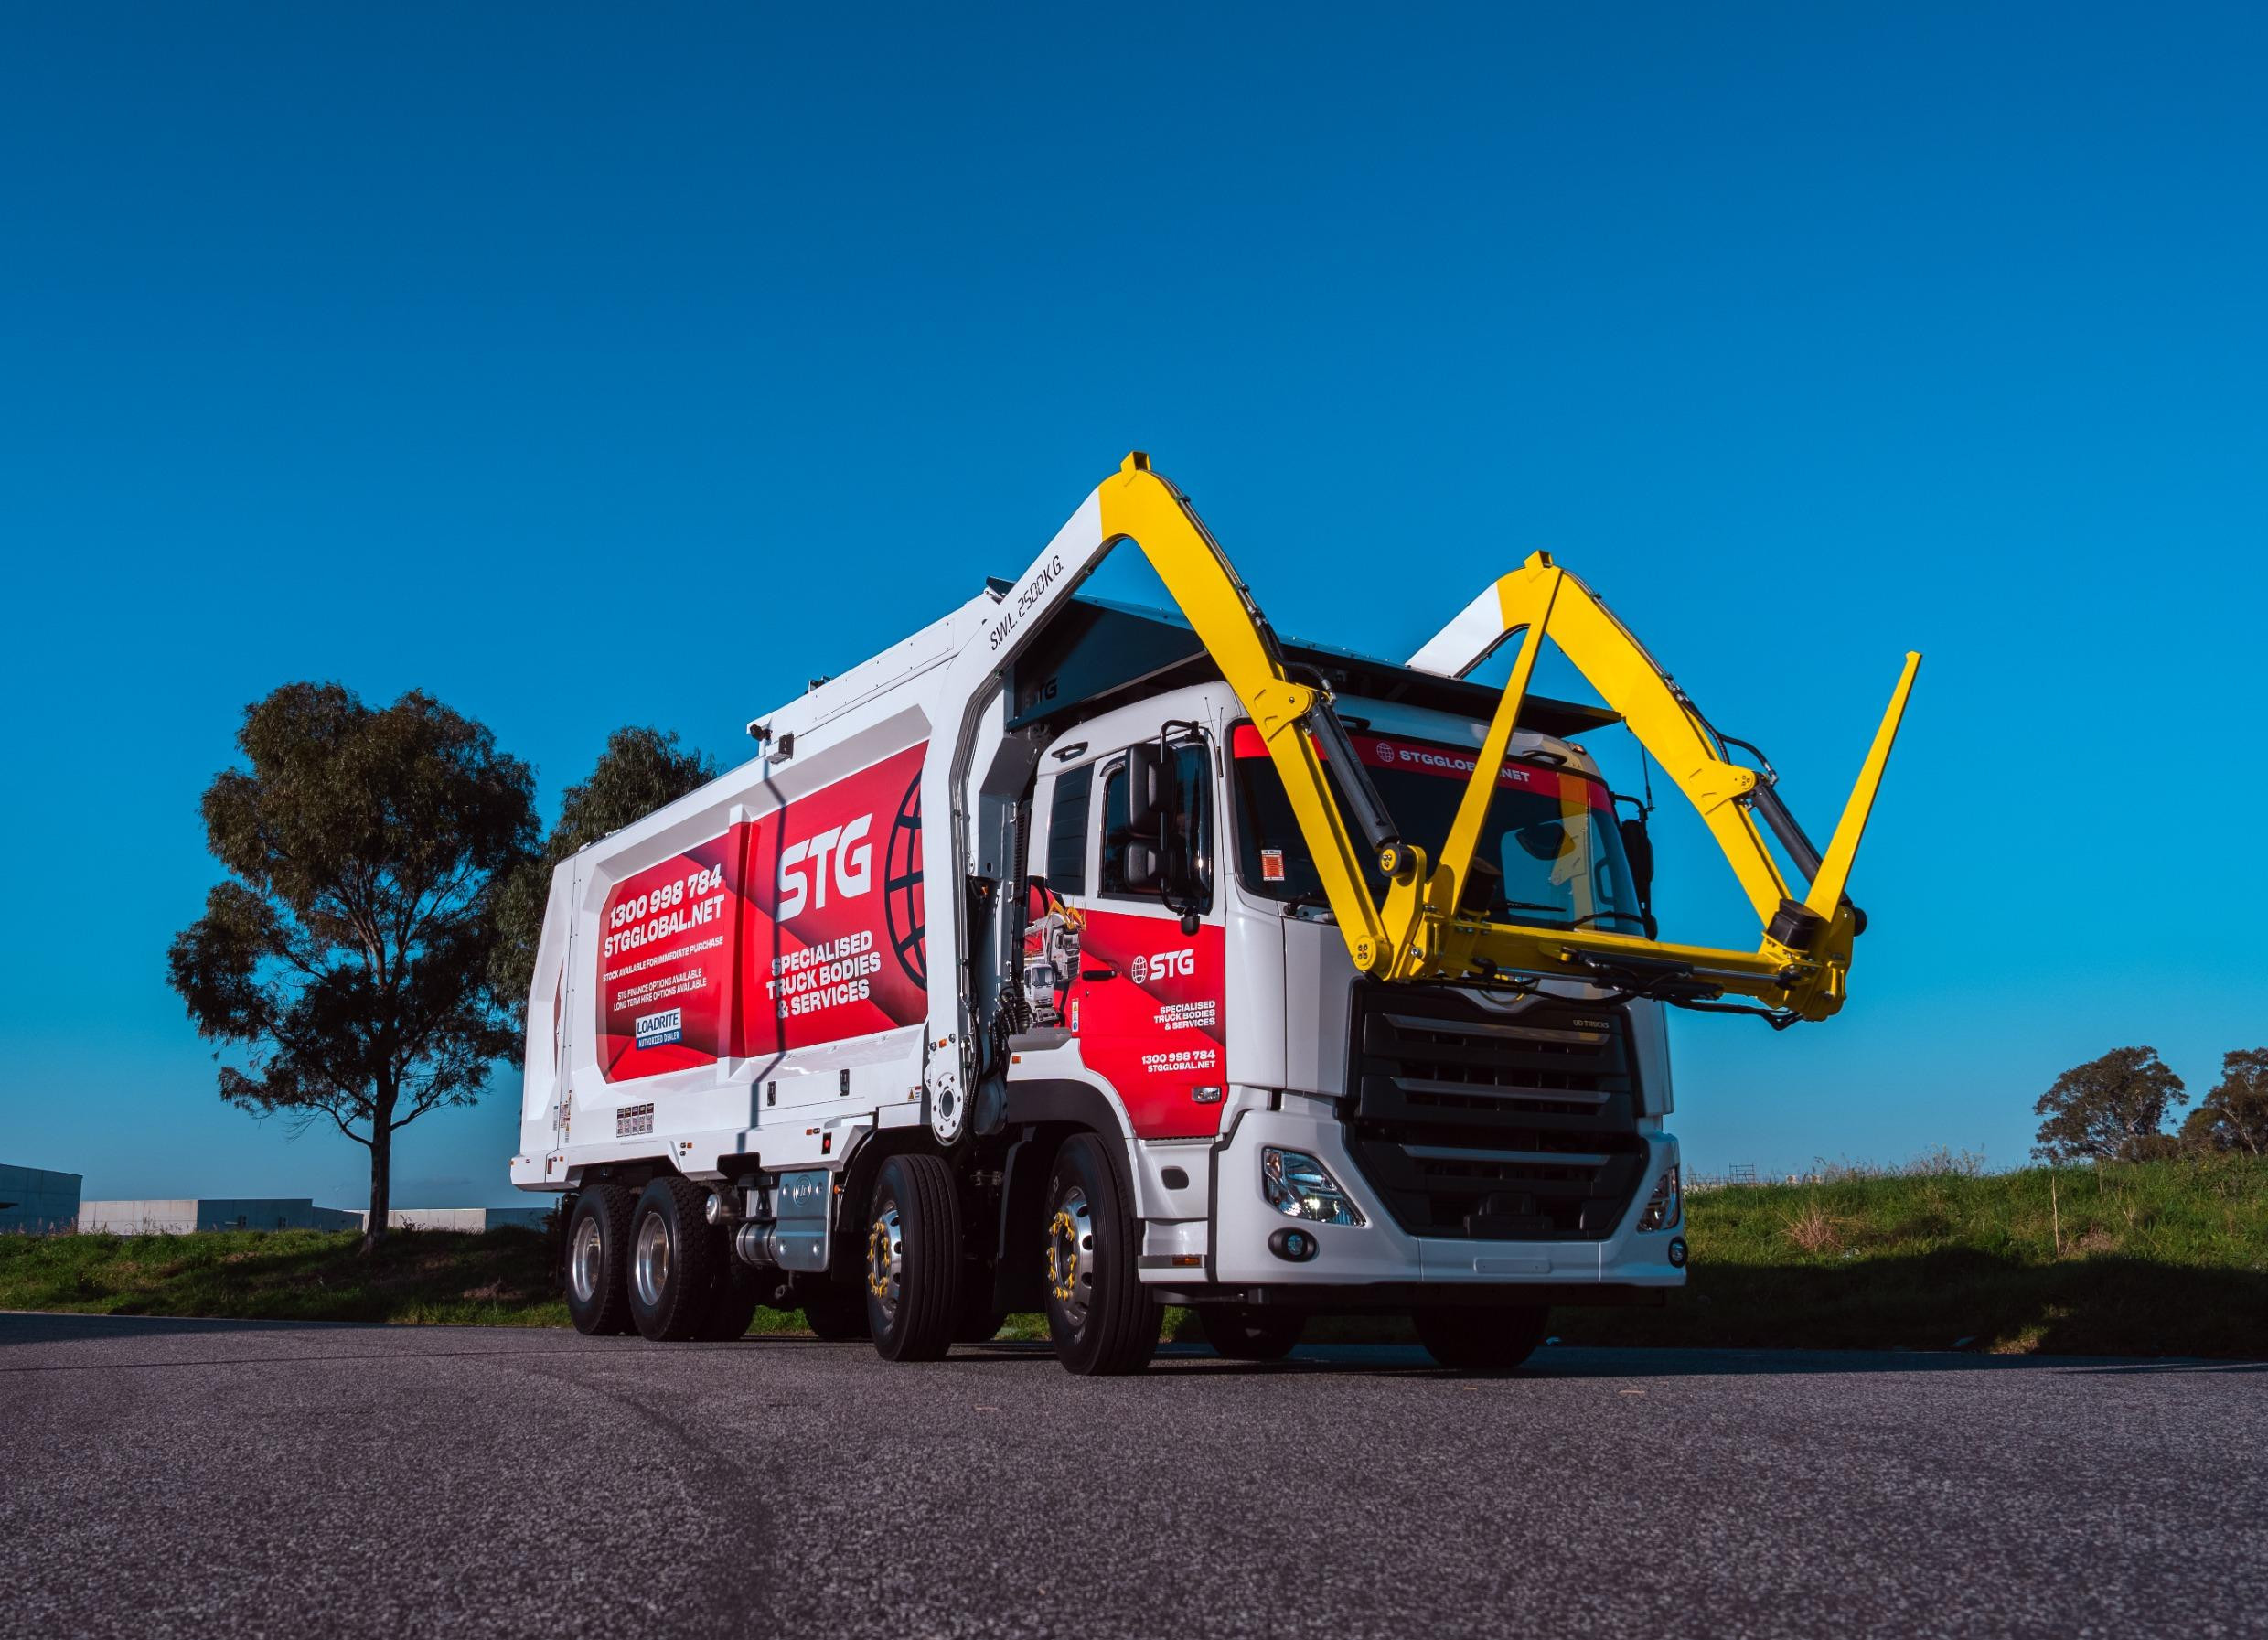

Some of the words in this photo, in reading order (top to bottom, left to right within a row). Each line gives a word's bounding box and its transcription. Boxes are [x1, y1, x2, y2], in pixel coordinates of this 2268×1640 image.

[1399, 750, 1530, 782] STGGLOB.NET
[776, 812, 872, 923] STG
[610, 895, 647, 929] 1300
[649, 880, 684, 913] 998
[687, 863, 722, 898] 784
[604, 894, 725, 958] STGGLOBAL.NET
[603, 970, 619, 982] STOCK
[619, 960, 646, 978] AVAILABLE
[646, 958, 658, 970] FOR
[658, 948, 690, 964] IMMEDIATE
[690, 936, 723, 954] PURCHASE
[772, 930, 872, 977] SPECIALISED
[1150, 949, 1194, 981] STG
[617, 991, 627, 1001] STG
[627, 983, 649, 998] FINANCE
[648, 976, 672, 991] OPTIONS
[671, 967, 702, 984] AVAILABLE
[765, 968, 818, 1000] TRUCK
[819, 951, 881, 986] BODIES
[613, 1001, 626, 1012] LONG
[627, 996, 640, 1008] TERM
[640, 992, 652, 1003] HIRE
[653, 986, 677, 1000] OPTIONS
[676, 977, 707, 993] AVAILABLE
[778, 999, 789, 1019] &
[790, 979, 870, 1016] SERVICES
[1160, 1000, 1215, 1014] SPECIALISED
[637, 1012, 679, 1034] LOADRITE
[1153, 1013, 1182, 1024] TRUCK
[1182, 1009, 1215, 1020] BODIES
[1164, 1023, 1171, 1031] &
[1172, 1017, 1215, 1030] SERVICES
[663, 1031, 679, 1042] DEALER
[1141, 1054, 1167, 1065] 1300
[1168, 1051, 1191, 1062] 998
[1192, 1049, 1216, 1061] 784
[1148, 1060, 1215, 1073] STGGLOBAL.NET
